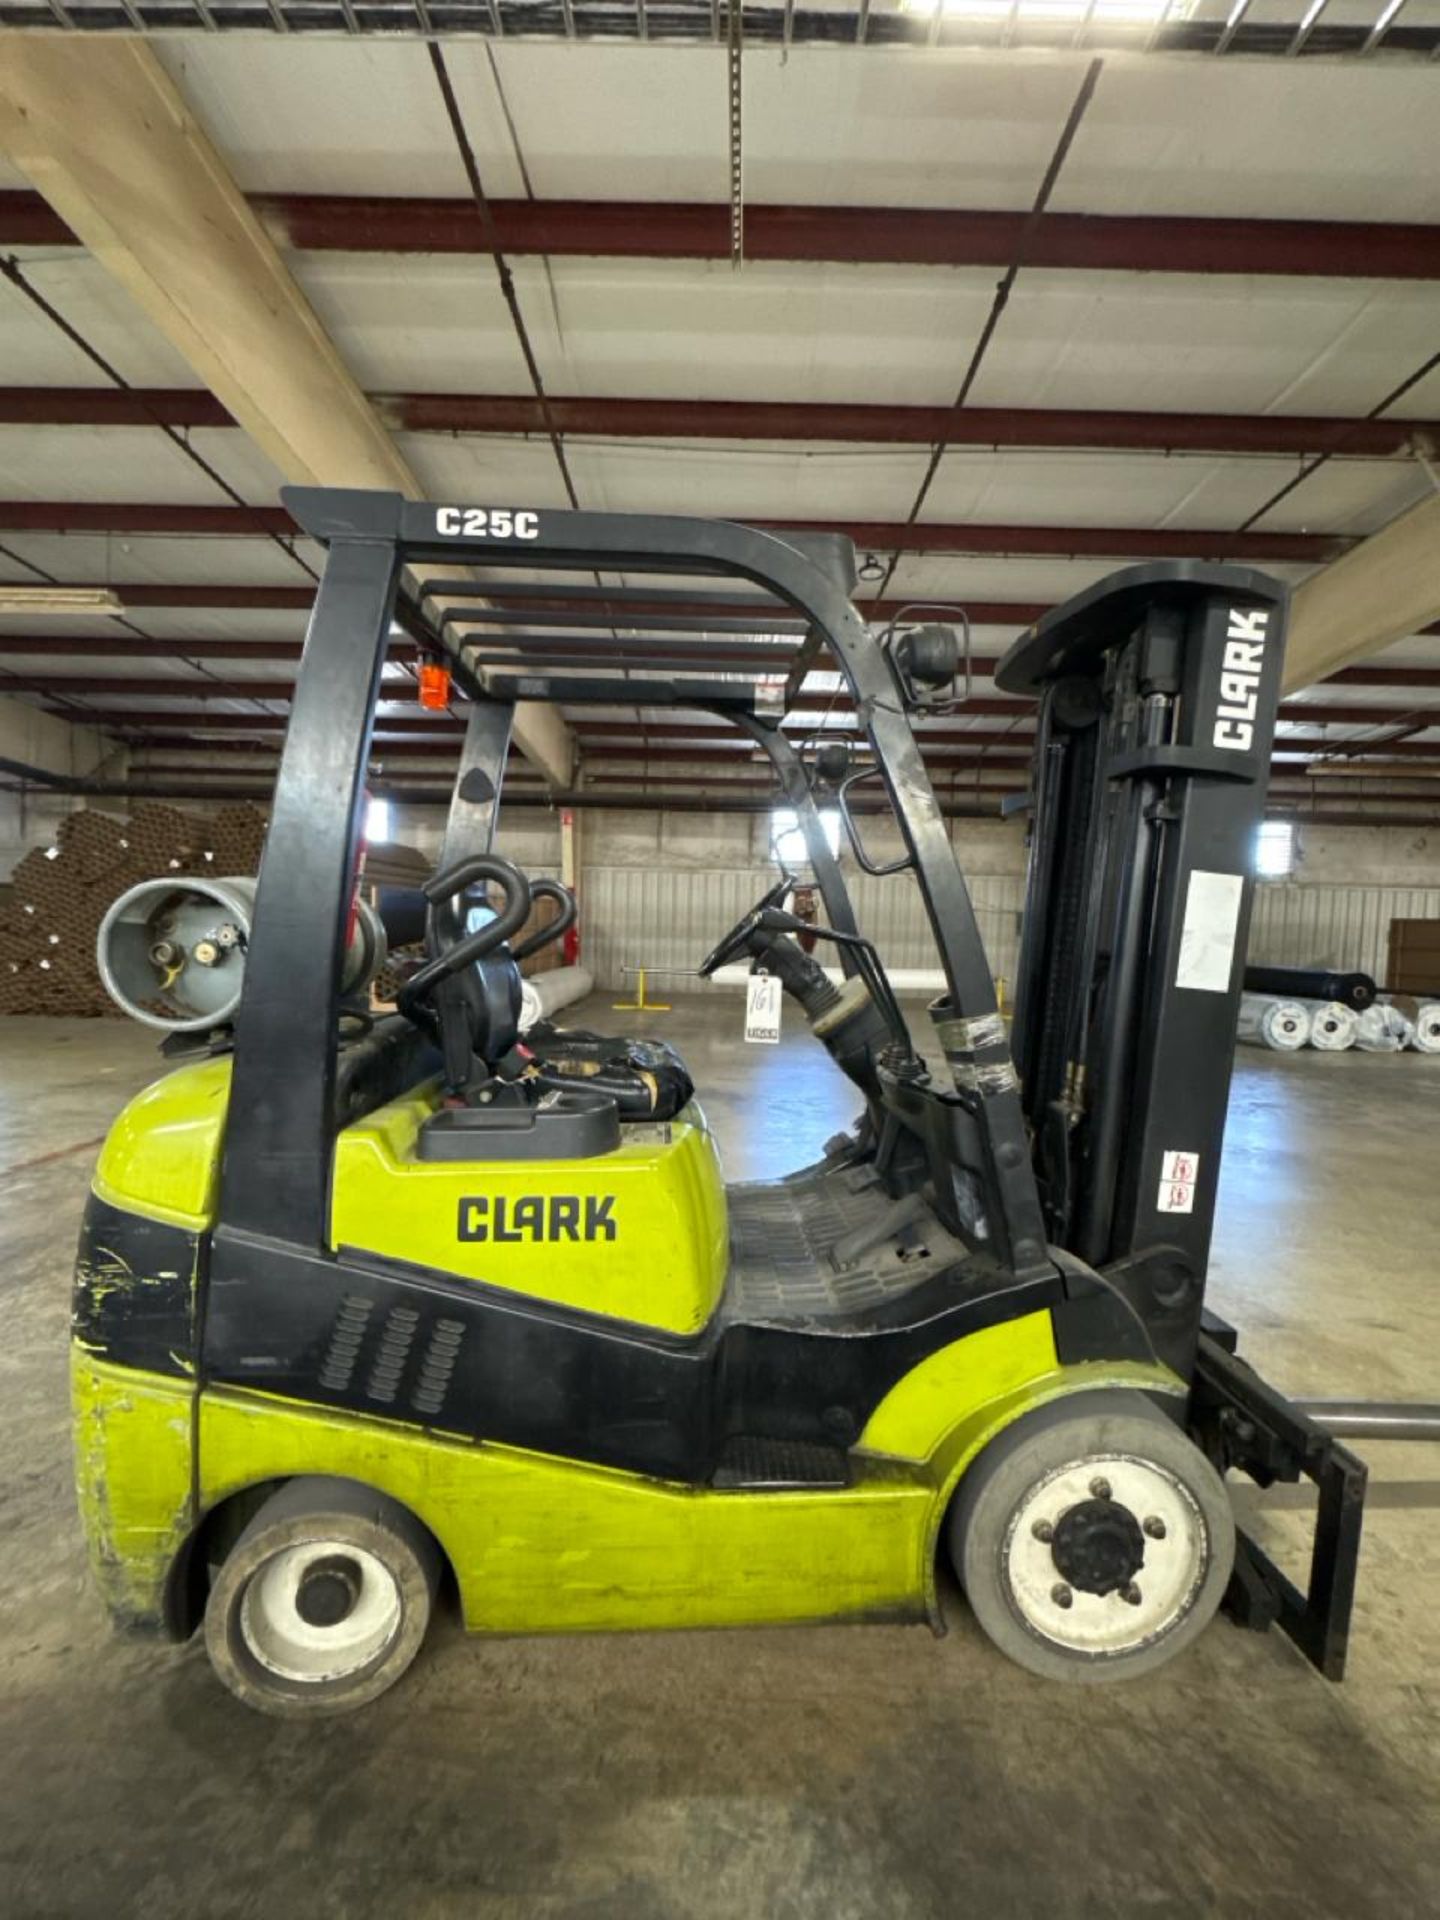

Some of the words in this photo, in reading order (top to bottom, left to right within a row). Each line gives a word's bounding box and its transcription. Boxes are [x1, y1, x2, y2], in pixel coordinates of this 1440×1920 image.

[436, 508, 539, 539] C25C
[1213, 609, 1269, 751] CLARK
[457, 1196, 616, 1243] CLARK
